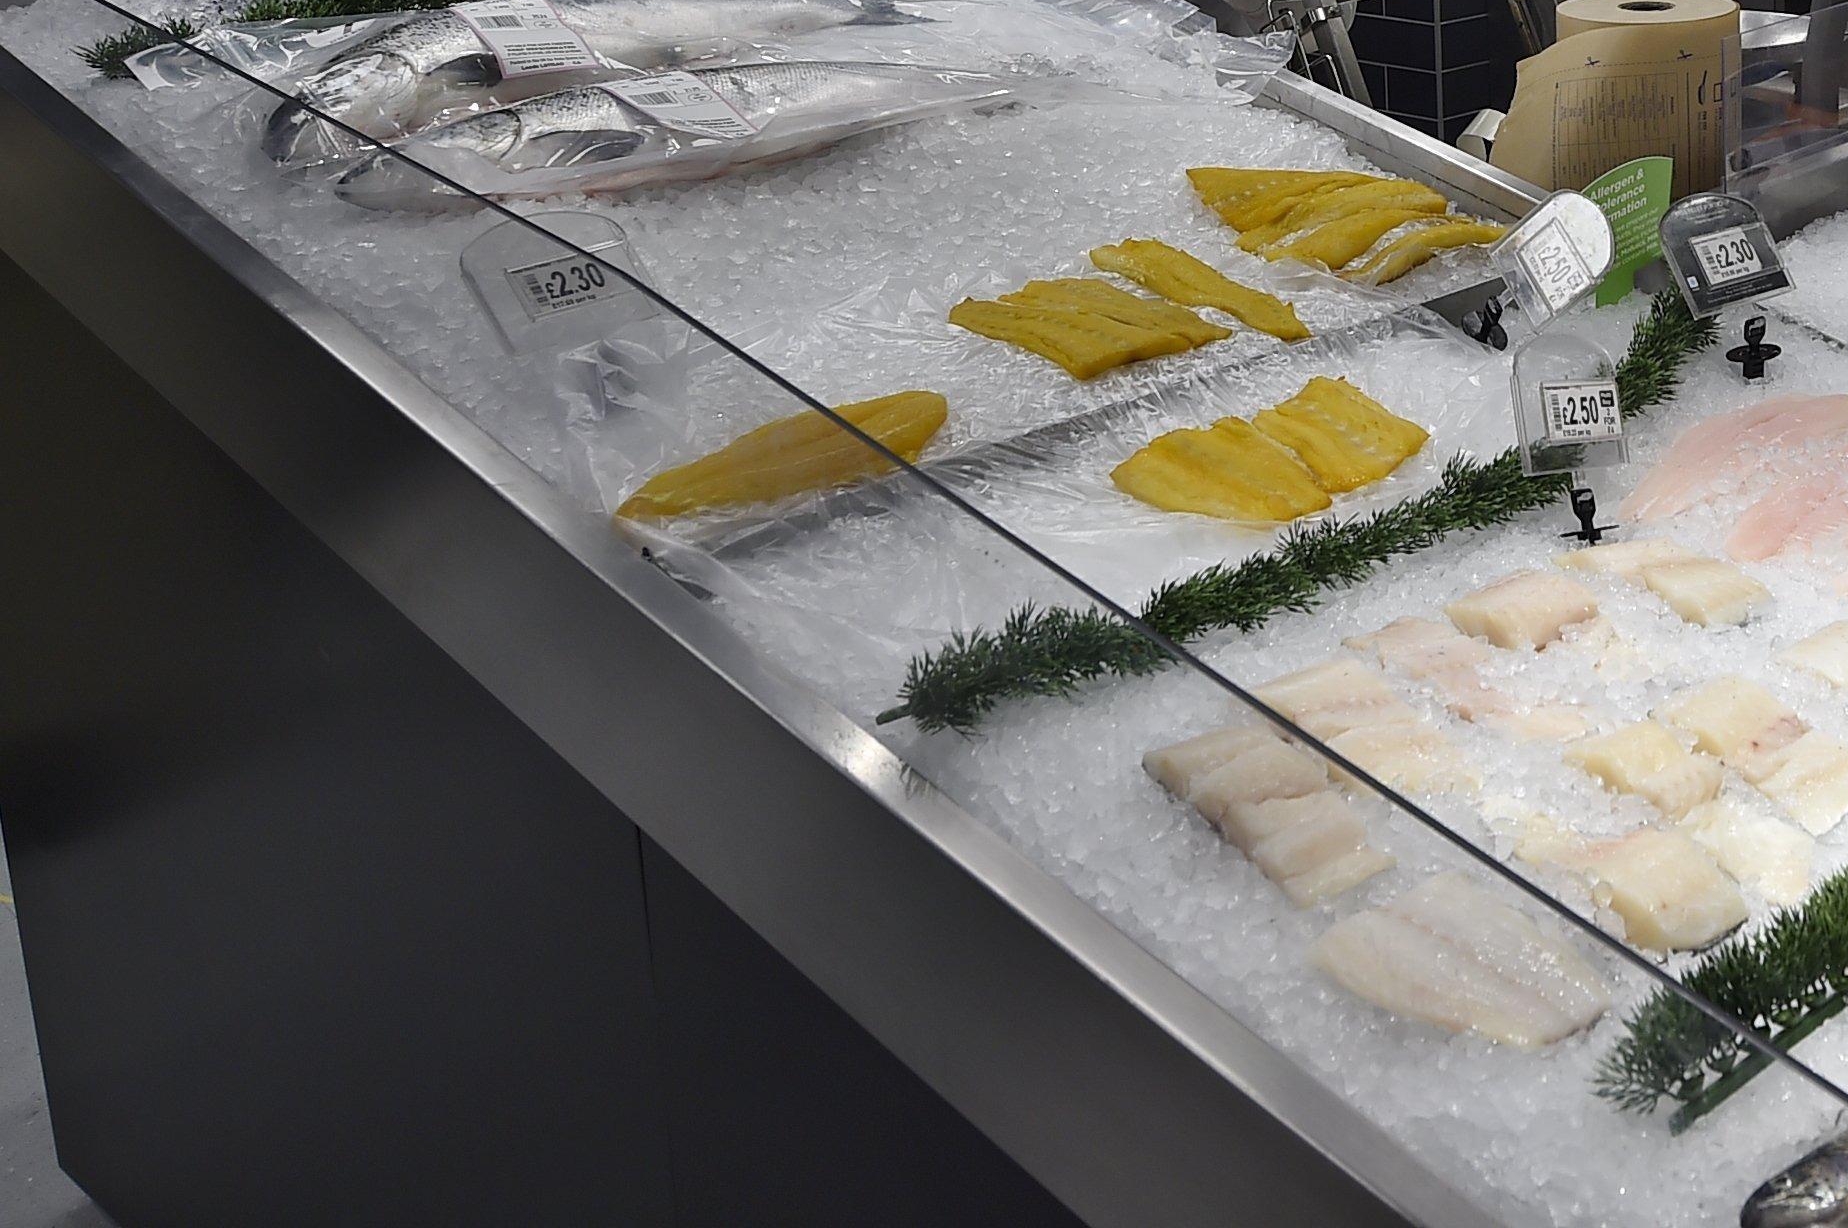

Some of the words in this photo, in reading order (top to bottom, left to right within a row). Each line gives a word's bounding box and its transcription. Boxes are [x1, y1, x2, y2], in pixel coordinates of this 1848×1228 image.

[1590, 174, 1635, 201] Allergen
[1636, 168, 1645, 180] &
[1598, 183, 1646, 211] olerance
[1606, 196, 1648, 222] rmation
[1538, 247, 1571, 283] £2.50
[1715, 238, 1754, 269] £2.30
[544, 261, 606, 299] £2.30
[1562, 396, 1599, 425] £2.50
